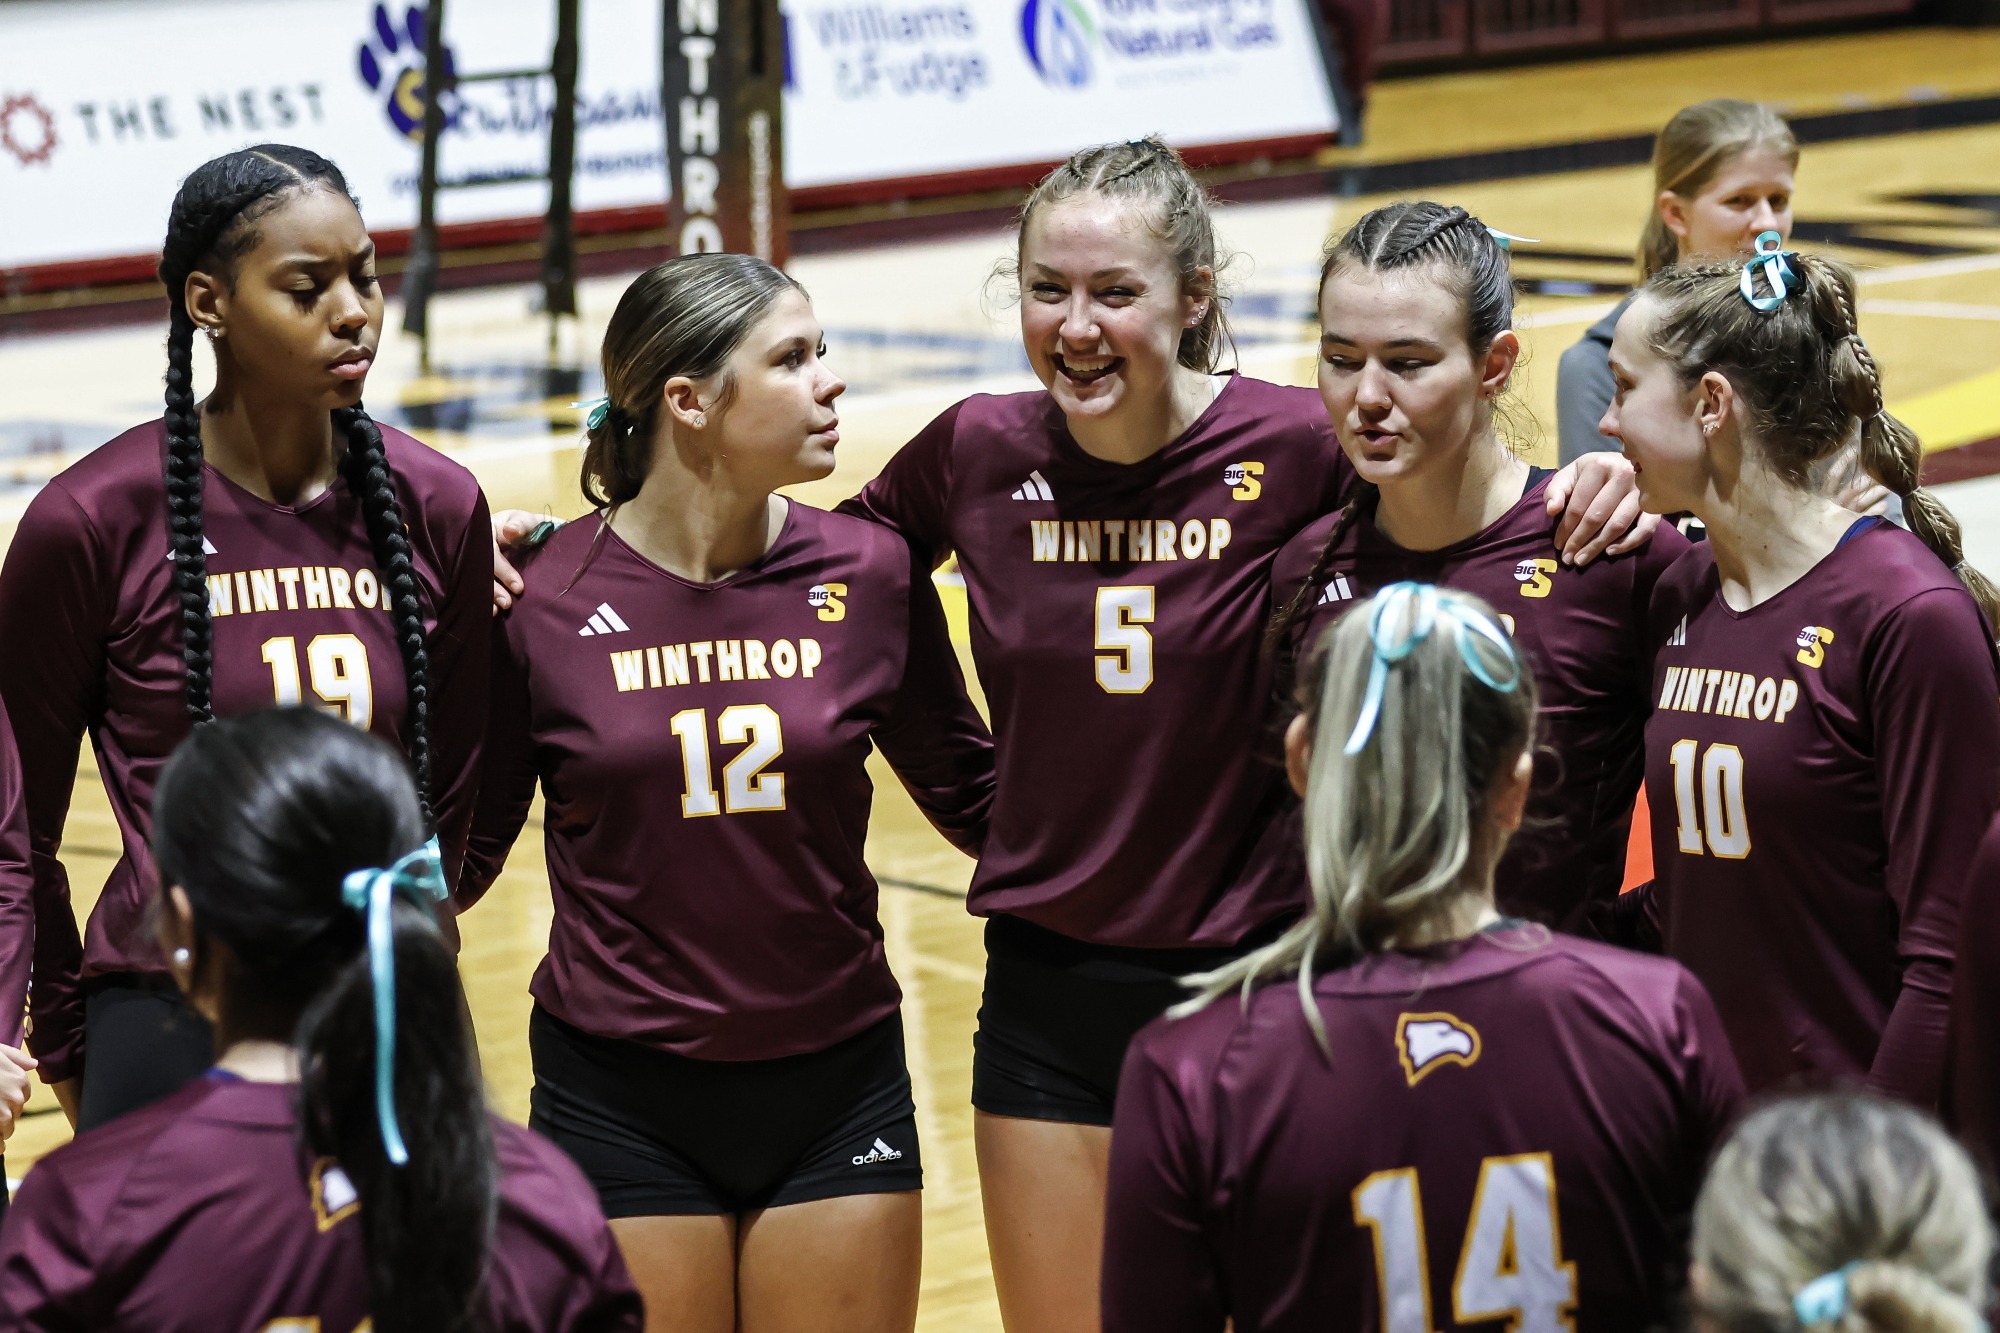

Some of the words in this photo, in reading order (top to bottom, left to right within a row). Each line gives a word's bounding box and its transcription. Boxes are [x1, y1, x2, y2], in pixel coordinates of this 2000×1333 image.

[808, 6, 972, 46] Williams
[1102, 27, 1212, 59] Natural
[862, 51, 988, 100] Fudge
[76, 98, 178, 145] THE
[199, 84, 324, 135] NEST
[1031, 519, 1231, 562] WINTHROP
[205, 566, 392, 617] WINTHRO
[610, 638, 822, 692] WINTHROP
[1095, 586, 1155, 693] 5
[261, 633, 373, 732] 19
[1658, 666, 1798, 723] WINTHROP
[670, 703, 786, 818] 12
[1670, 738, 1751, 859] 10
[852, 1150, 902, 1165] adidas
[1351, 1151, 1578, 1333] 14
